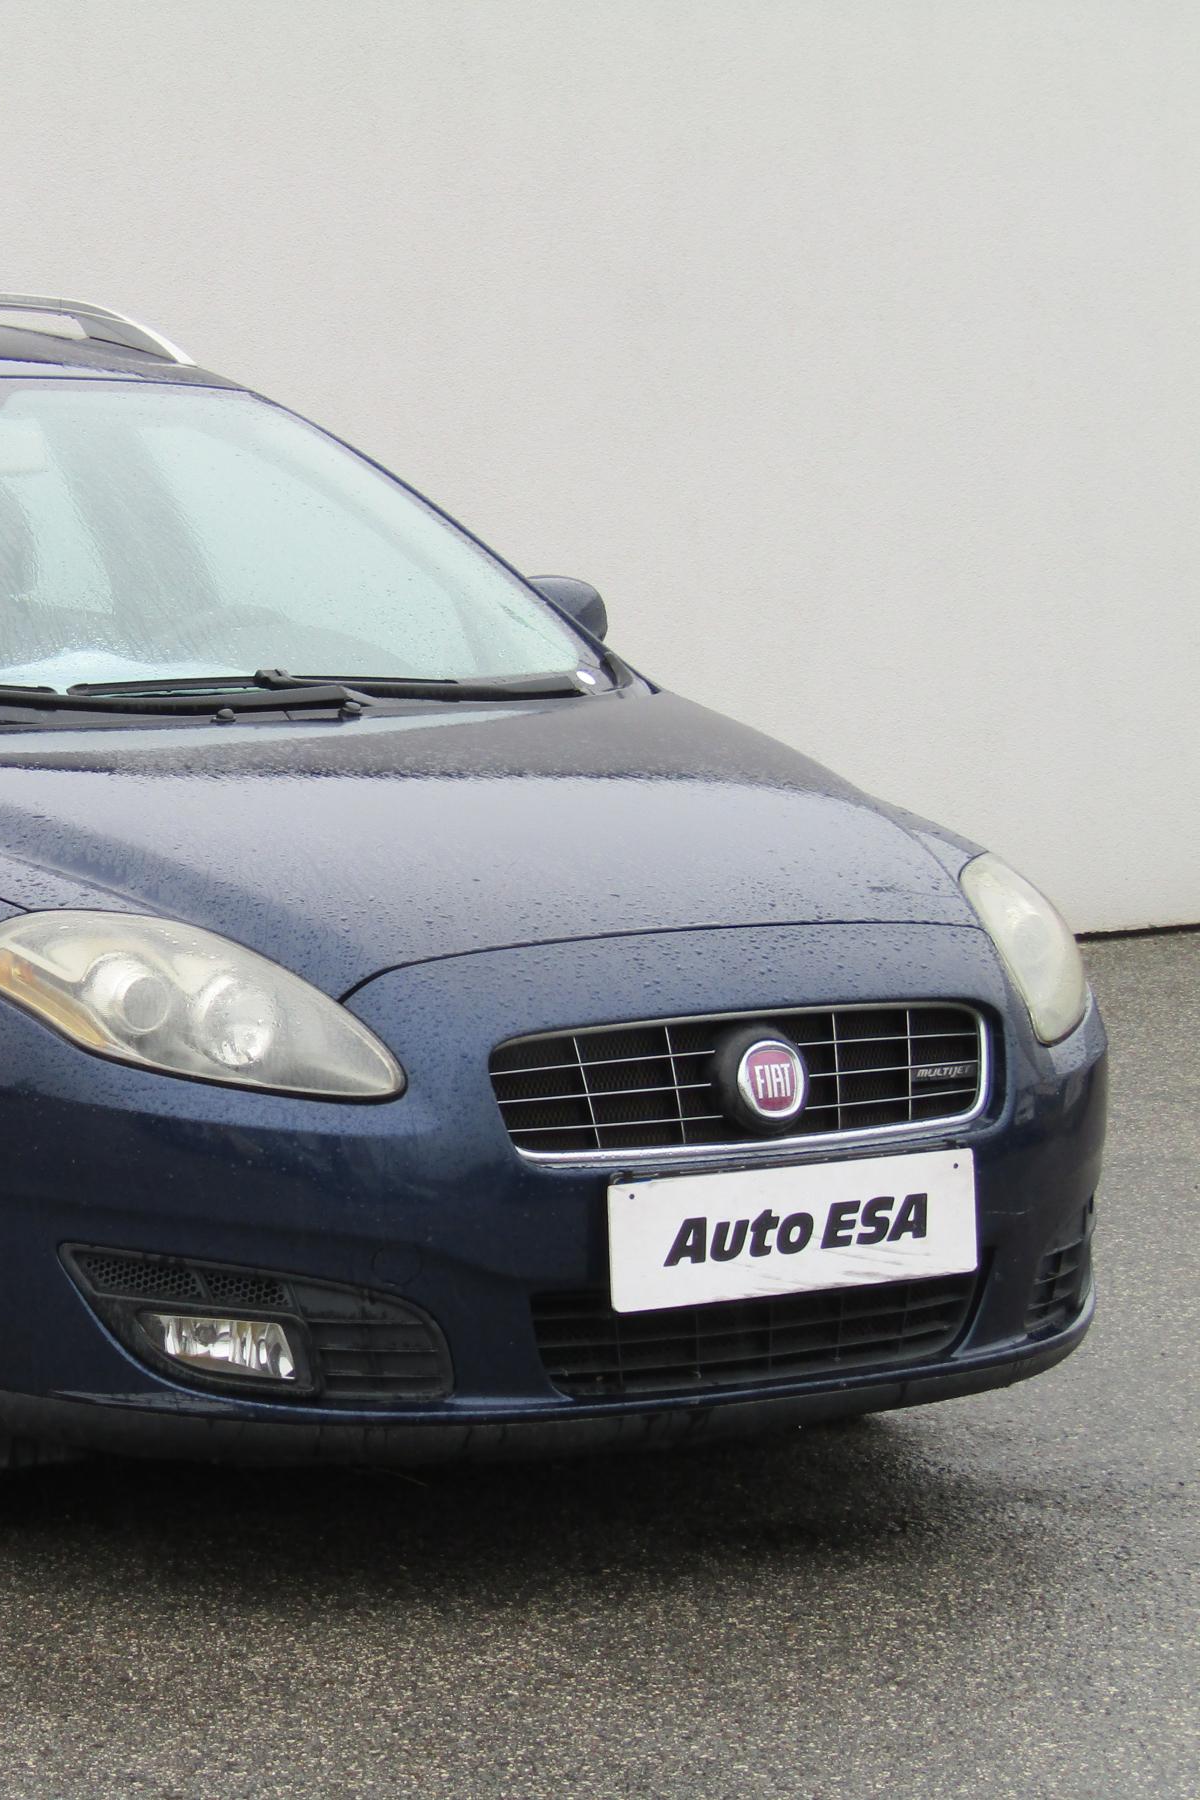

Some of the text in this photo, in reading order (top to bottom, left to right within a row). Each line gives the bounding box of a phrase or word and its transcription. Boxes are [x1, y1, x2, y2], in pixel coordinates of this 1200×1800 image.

[754, 1063, 791, 1098] FIAT
[664, 1193, 928, 1267] Auto ESA
